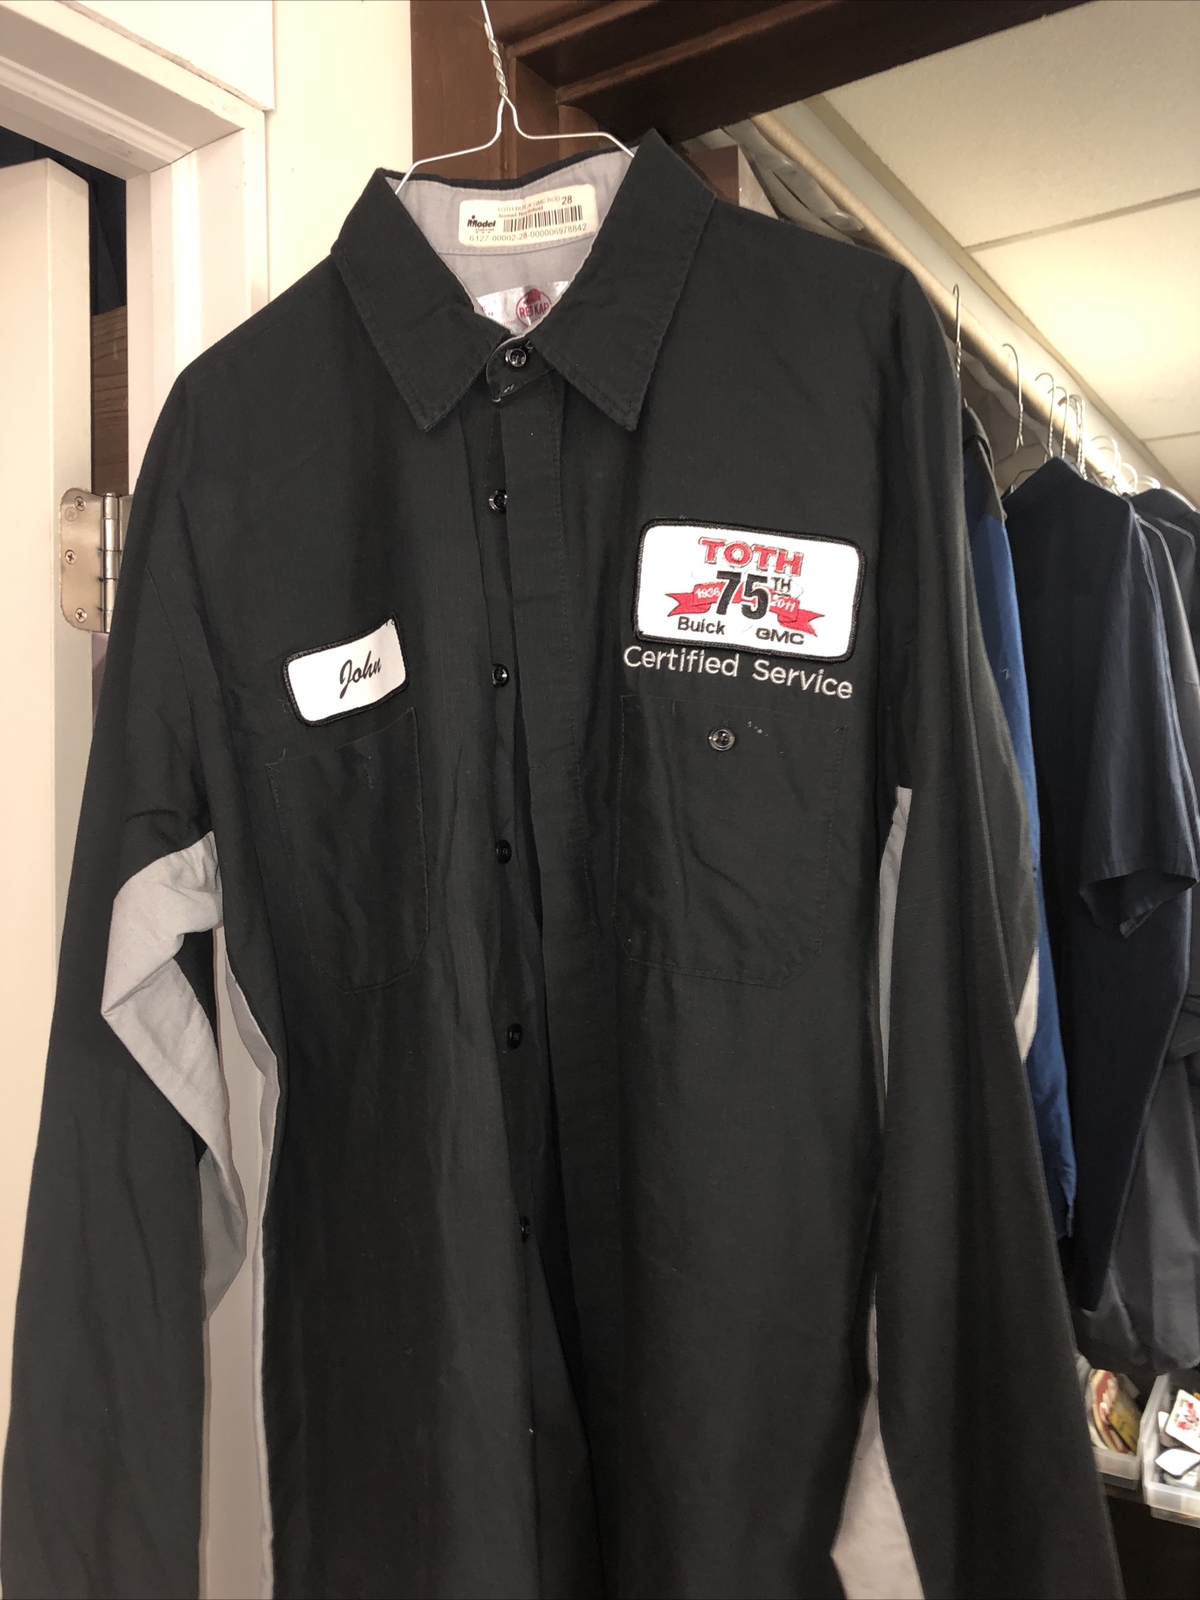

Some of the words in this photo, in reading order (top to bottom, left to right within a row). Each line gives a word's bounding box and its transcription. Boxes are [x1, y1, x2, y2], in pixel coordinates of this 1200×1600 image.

[561, 195, 573, 205] 28
[467, 215, 496, 228] Model
[698, 536, 804, 577] TOTH
[770, 598, 795, 612] 2011
[677, 616, 726, 636] Buick
[755, 627, 805, 646] GMC
[339, 650, 382, 699] John
[623, 645, 740, 677] Certified
[752, 659, 854, 700] Service
